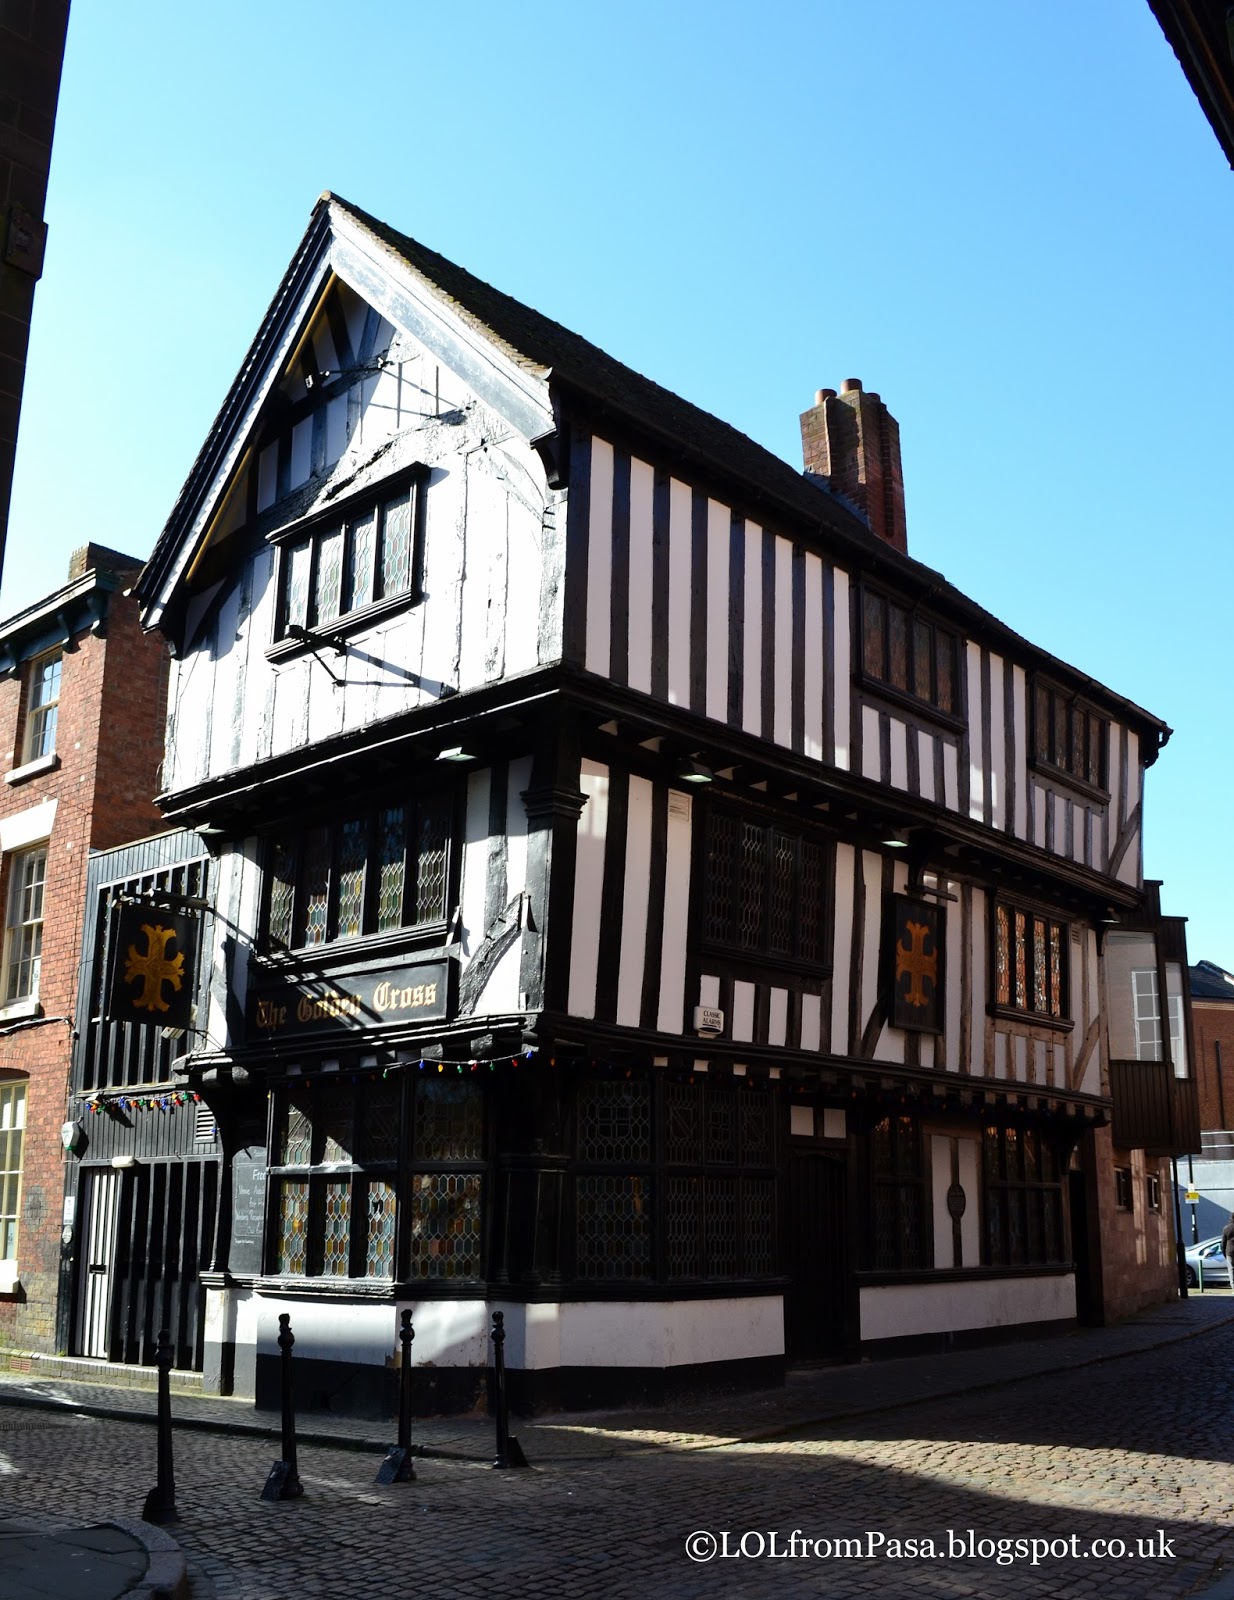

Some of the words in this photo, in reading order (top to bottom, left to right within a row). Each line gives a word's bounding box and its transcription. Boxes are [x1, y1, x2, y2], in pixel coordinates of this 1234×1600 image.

[255, 998, 287, 1031] The
[296, 989, 362, 1023] Golden
[372, 981, 437, 1013] Cross
[703, 1010, 721, 1019] CLASSIC
[702, 1017, 722, 1026] ALARMS
